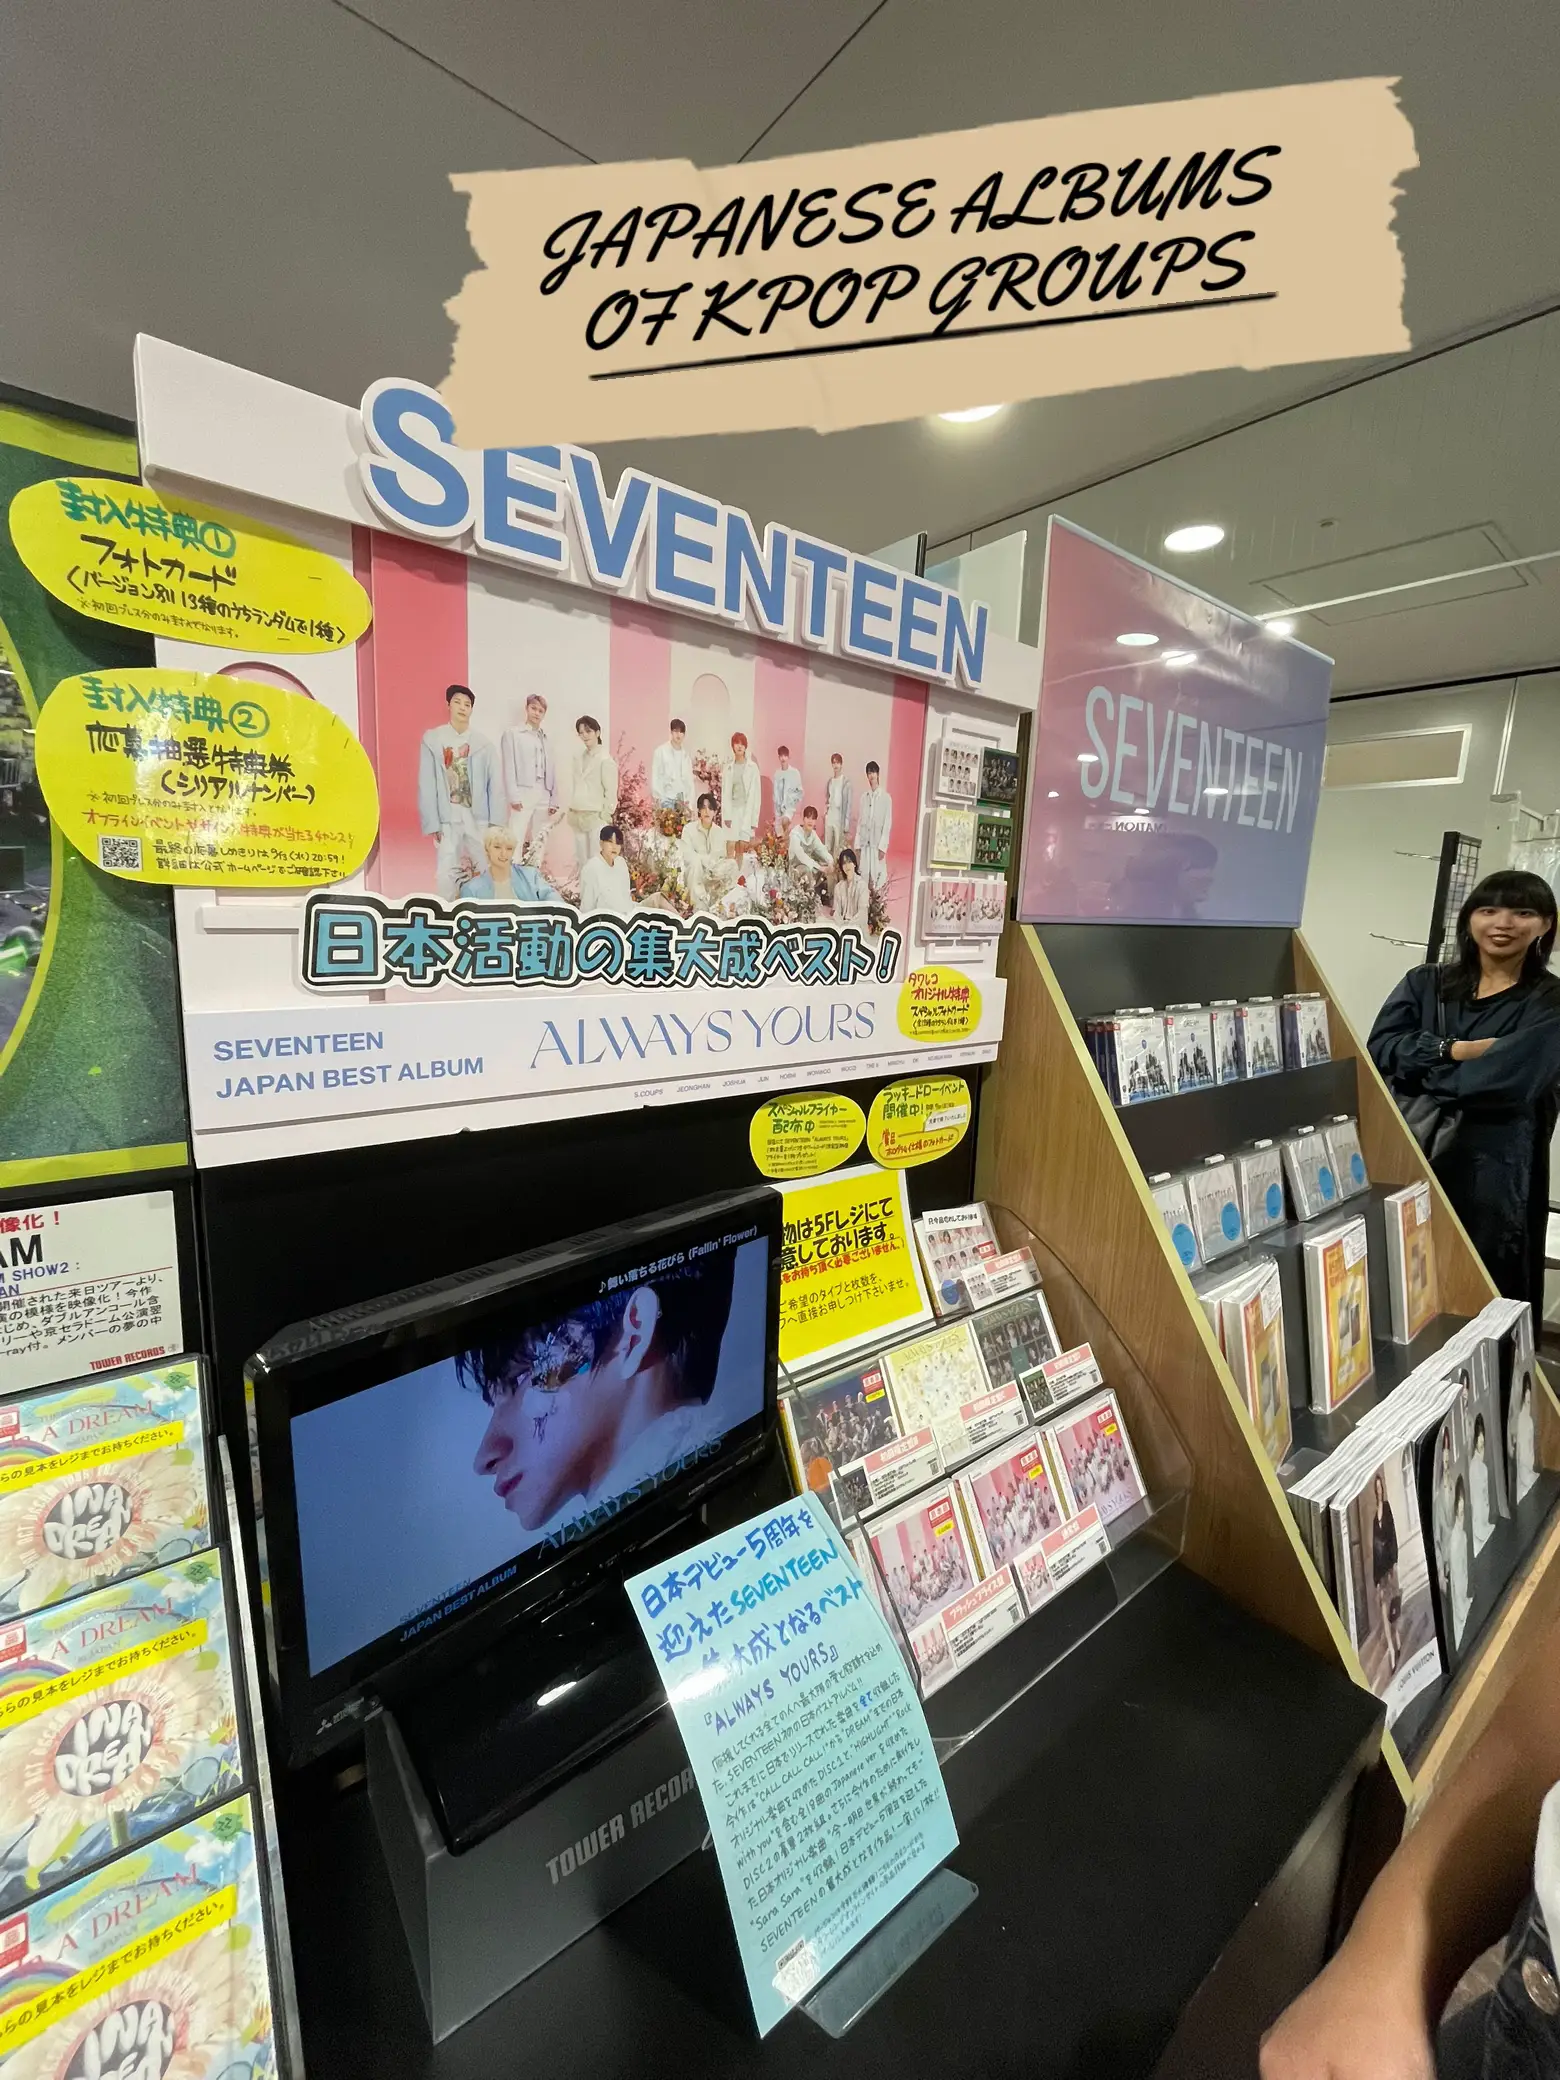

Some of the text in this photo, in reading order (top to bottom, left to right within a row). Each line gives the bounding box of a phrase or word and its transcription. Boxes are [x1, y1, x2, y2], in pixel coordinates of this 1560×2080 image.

[81, 533, 237, 592] フォトカード
[370, 387, 988, 684] SEVENTEEN
[1081, 686, 1303, 833] SEVENTEEN
[314, 907, 899, 982] 日本活動の集大成ベスト!
[213, 1031, 384, 1061] SEVENTEEN
[530, 1001, 877, 1069] ALWAYS YOURS
[216, 1057, 484, 1098] JAPAN BEST ALBUM
[90, 1356, 122, 1371] TOWER
[124, 1346, 165, 1363] RECORDS
[69, 1400, 152, 1435] DREAM
[638, 1503, 817, 1621] 日本デビュー5周年を
[81, 1597, 174, 1648] DREAM
[399, 1564, 517, 1643] JAPAN BEST ALBUM
[653, 1534, 842, 1665] 迎えたSEVENTEEN
[546, 1821, 625, 1883] TOWER
